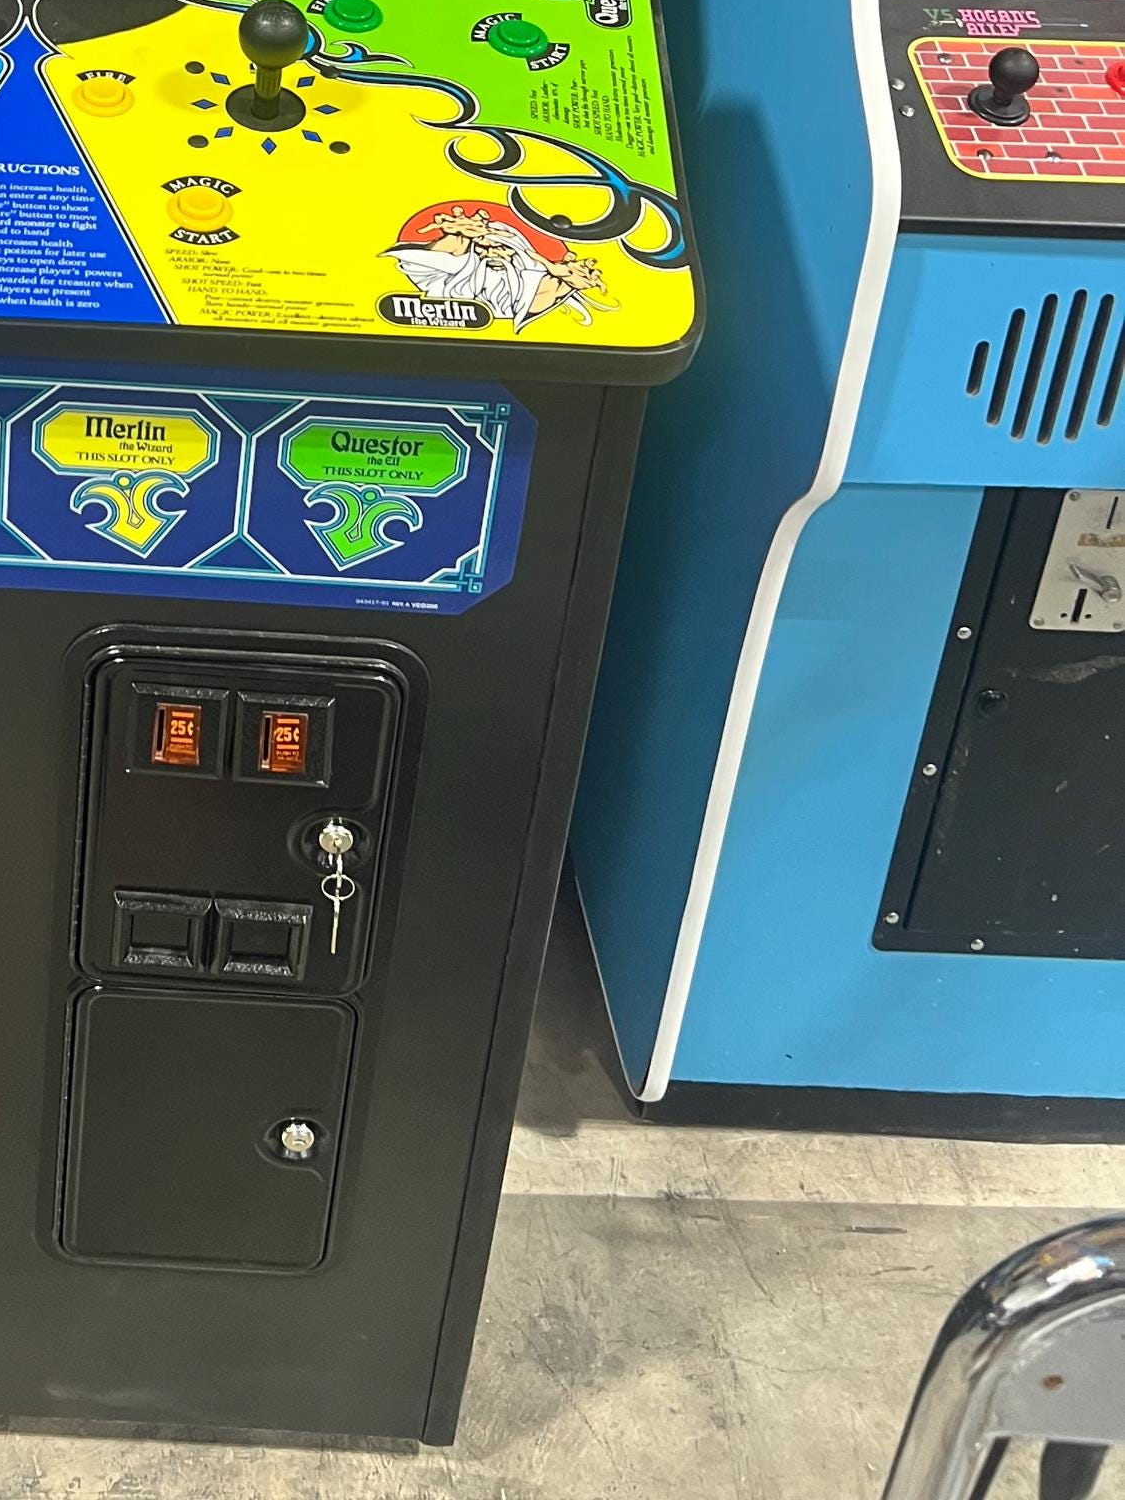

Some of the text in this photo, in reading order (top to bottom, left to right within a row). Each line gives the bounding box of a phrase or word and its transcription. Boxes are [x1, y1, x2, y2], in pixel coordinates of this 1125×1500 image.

[923, 8, 1041, 24] VS HOGAN'S
[473, 13, 517, 41] MAGIC
[967, 22, 1041, 36] ALLEY
[530, 44, 568, 70] START
[85, 71, 127, 84] FIRE
[9, 184, 53, 192] increases
[56, 184, 87, 193] health
[169, 177, 234, 194] MAGIC
[49, 195, 69, 203] any
[12, 201, 46, 210] button
[61, 203, 89, 212] shoot
[18, 210, 53, 219] button
[14, 220, 56, 228] monster
[58, 221, 70, 229] to
[72, 221, 97, 231] fight
[23, 227, 50, 236] hand
[174, 229, 233, 244] START
[41, 238, 74, 248] health
[4, 247, 43, 256] potions
[44, 248, 60, 256] for
[63, 248, 86, 257] later
[89, 251, 107, 259] use
[29, 258, 56, 266] open
[57, 258, 87, 267] doors
[84, 269, 123, 278] powers
[40, 276, 56, 285] for
[58, 278, 102, 287] treasure
[103, 280, 134, 289] when
[32, 287, 50, 295] are
[52, 288, 91, 297] present
[29, 297, 62, 307] health
[65, 299, 75, 307] is
[76, 300, 100, 308] zero
[392, 296, 477, 321] Merlin
[428, 317, 466, 328] Wizard
[85, 415, 166, 441] Merlin
[119, 441, 173, 453] the Wizard
[331, 430, 424, 456] Questor
[75, 451, 176, 465] THIS SLOT ONLY
[367, 456, 401, 466] the Elf
[322, 466, 424, 480] THIS SLOT ONLY
[170, 720, 194, 736] 25¢
[276, 727, 300, 742] 25¢
